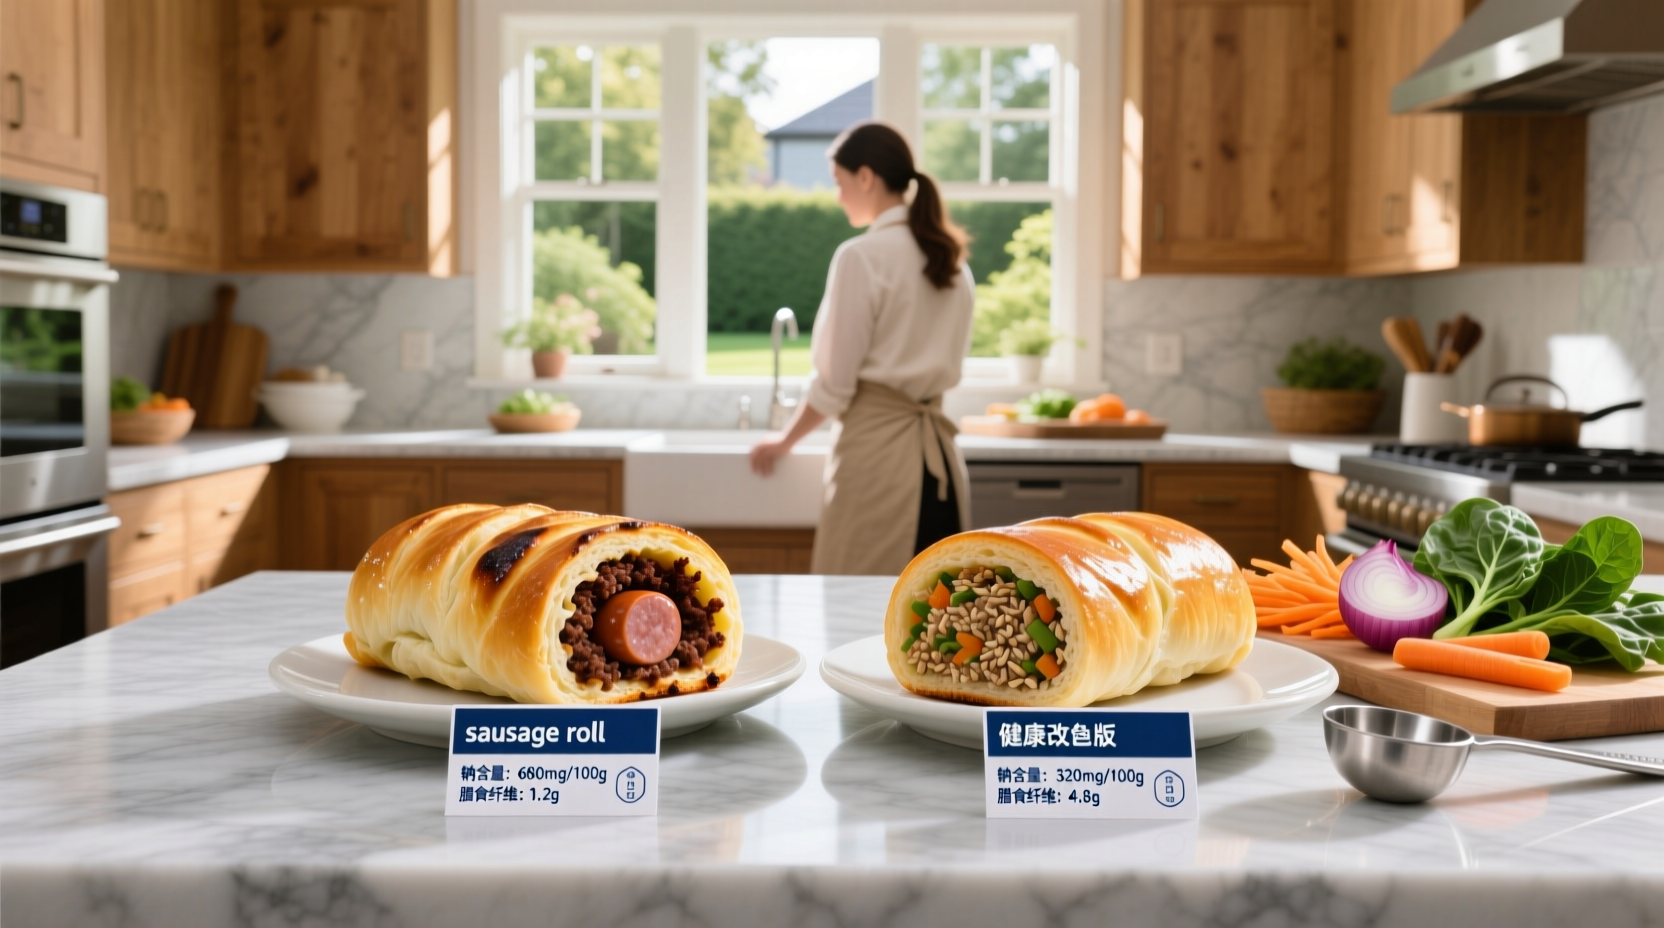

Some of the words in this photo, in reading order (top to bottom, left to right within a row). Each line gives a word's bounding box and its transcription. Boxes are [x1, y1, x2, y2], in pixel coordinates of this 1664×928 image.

[465, 726, 559, 748] sausage
[567, 720, 605, 743] roll
[1056, 768, 1144, 787] 320mg/100g
[529, 787, 560, 804] 1.2g
